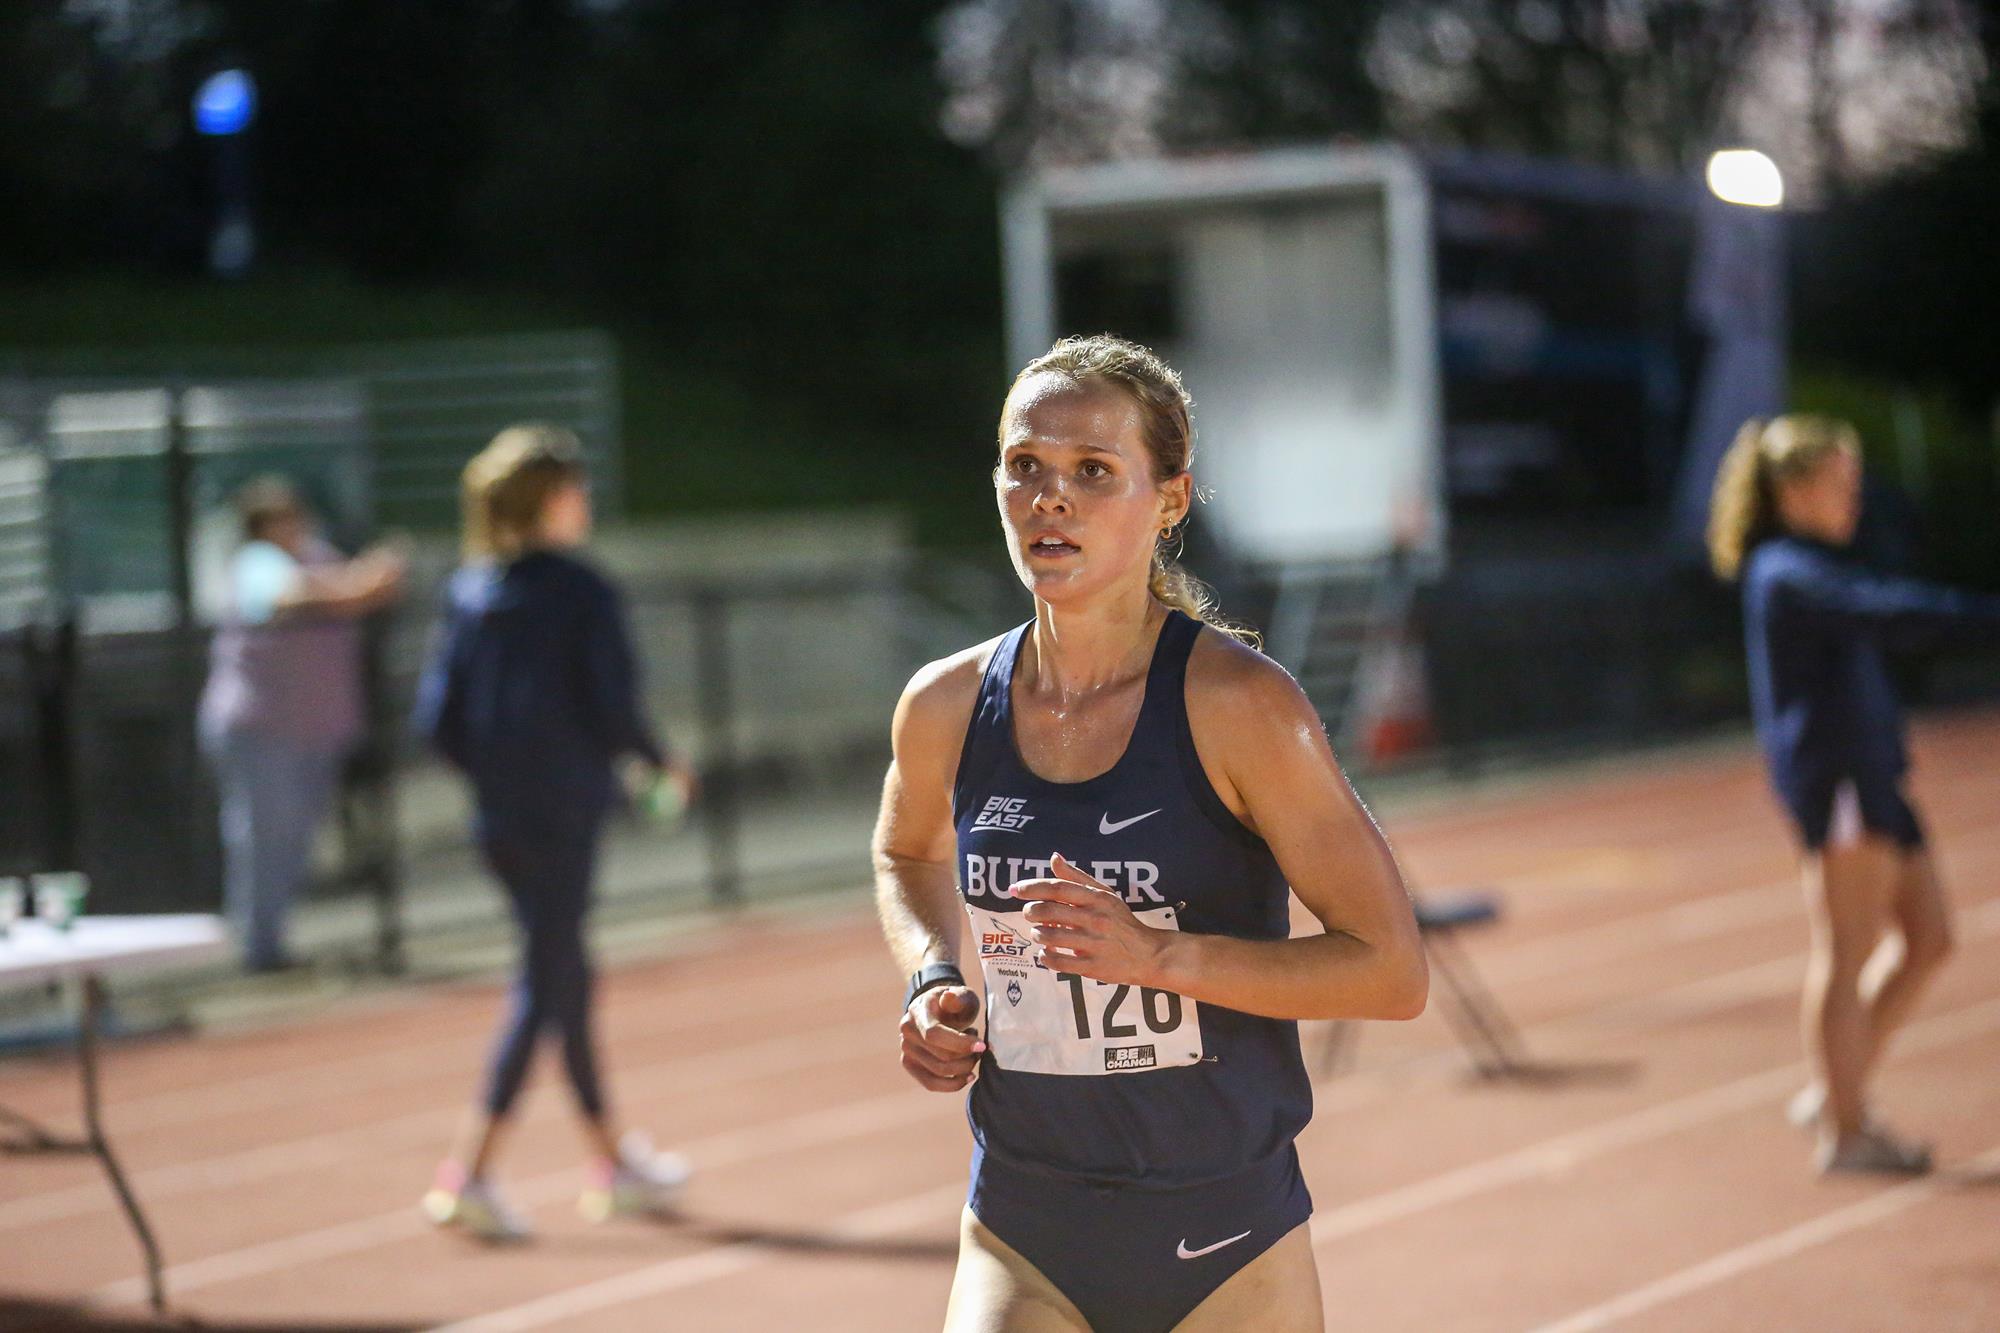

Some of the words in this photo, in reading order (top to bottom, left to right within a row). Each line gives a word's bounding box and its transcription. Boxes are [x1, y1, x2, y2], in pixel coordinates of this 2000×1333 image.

[983, 795, 1028, 812] BIG
[974, 811, 1035, 828] EAST
[966, 853, 1165, 904] BUTER
[982, 933, 1014, 944] BIG
[981, 944, 1028, 956] EAST
[1056, 972, 1183, 1040] 126
[1106, 1056, 1154, 1069] CHANGE
